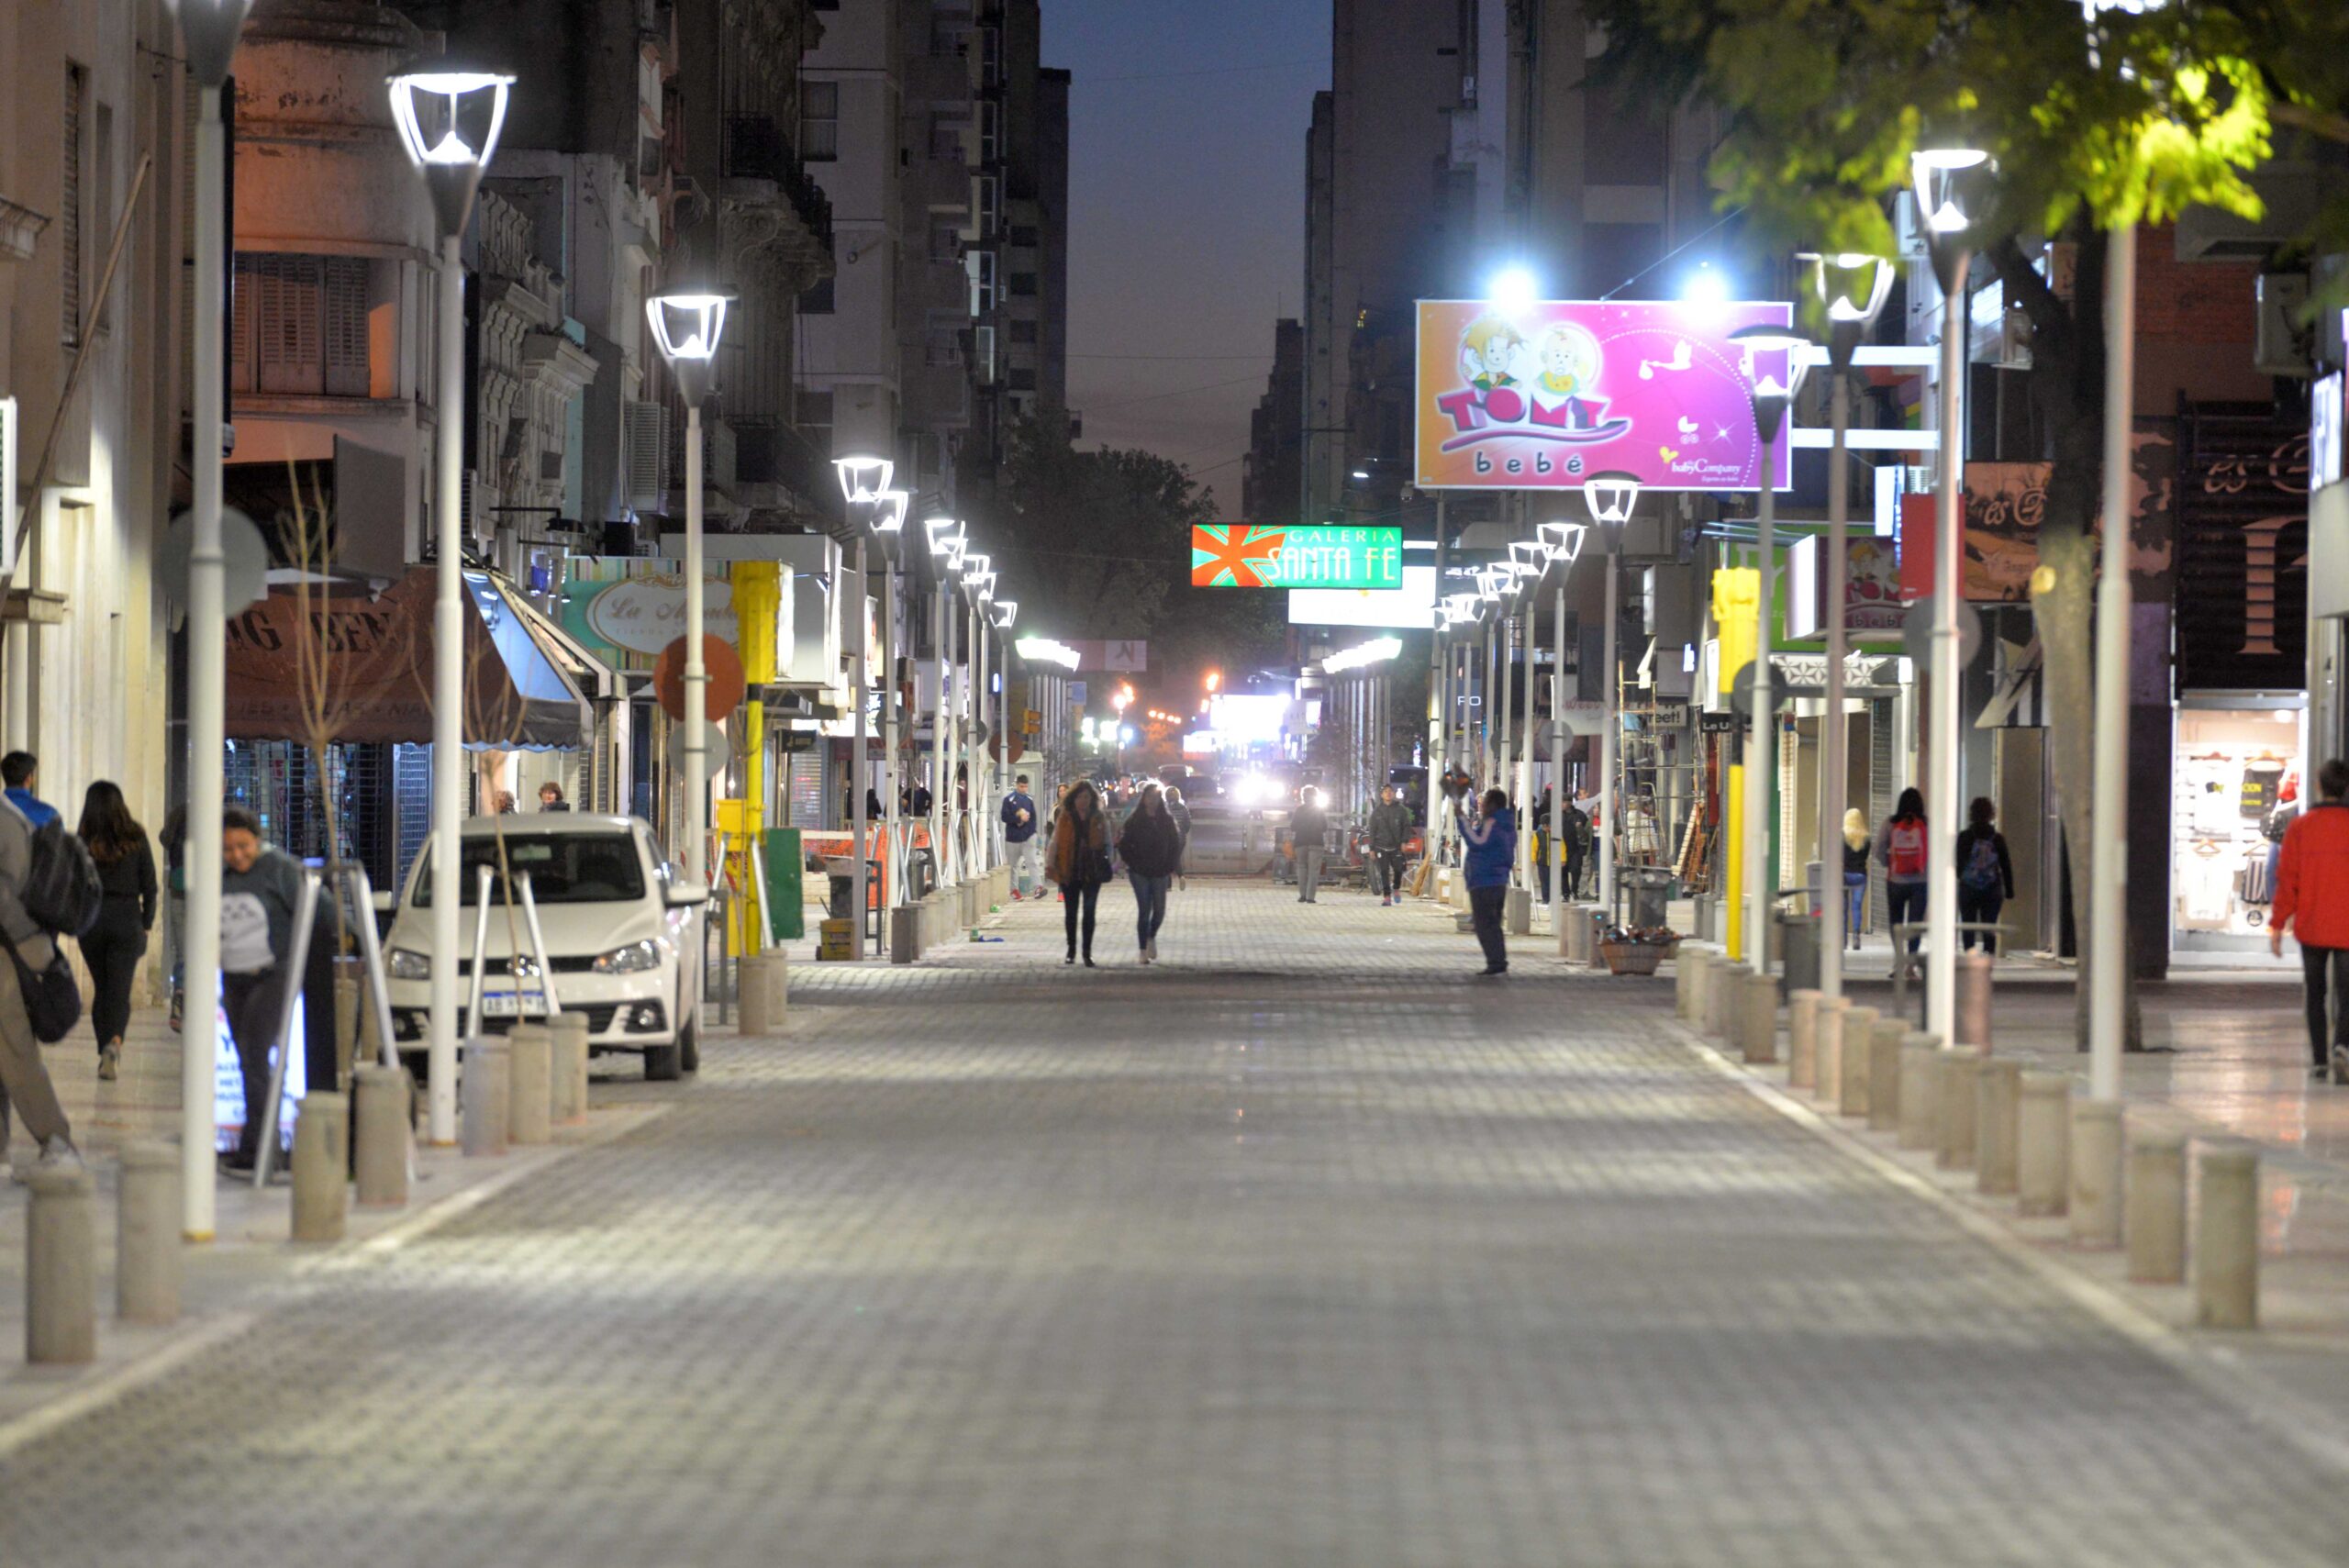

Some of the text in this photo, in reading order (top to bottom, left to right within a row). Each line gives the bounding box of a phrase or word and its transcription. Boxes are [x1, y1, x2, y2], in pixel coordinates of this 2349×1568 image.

[1437, 385, 1611, 433] TOMY
[1475, 450, 1584, 473] bebé
[1289, 529, 1396, 543] GALERIA
[1267, 546, 1397, 581] SANTA FE
